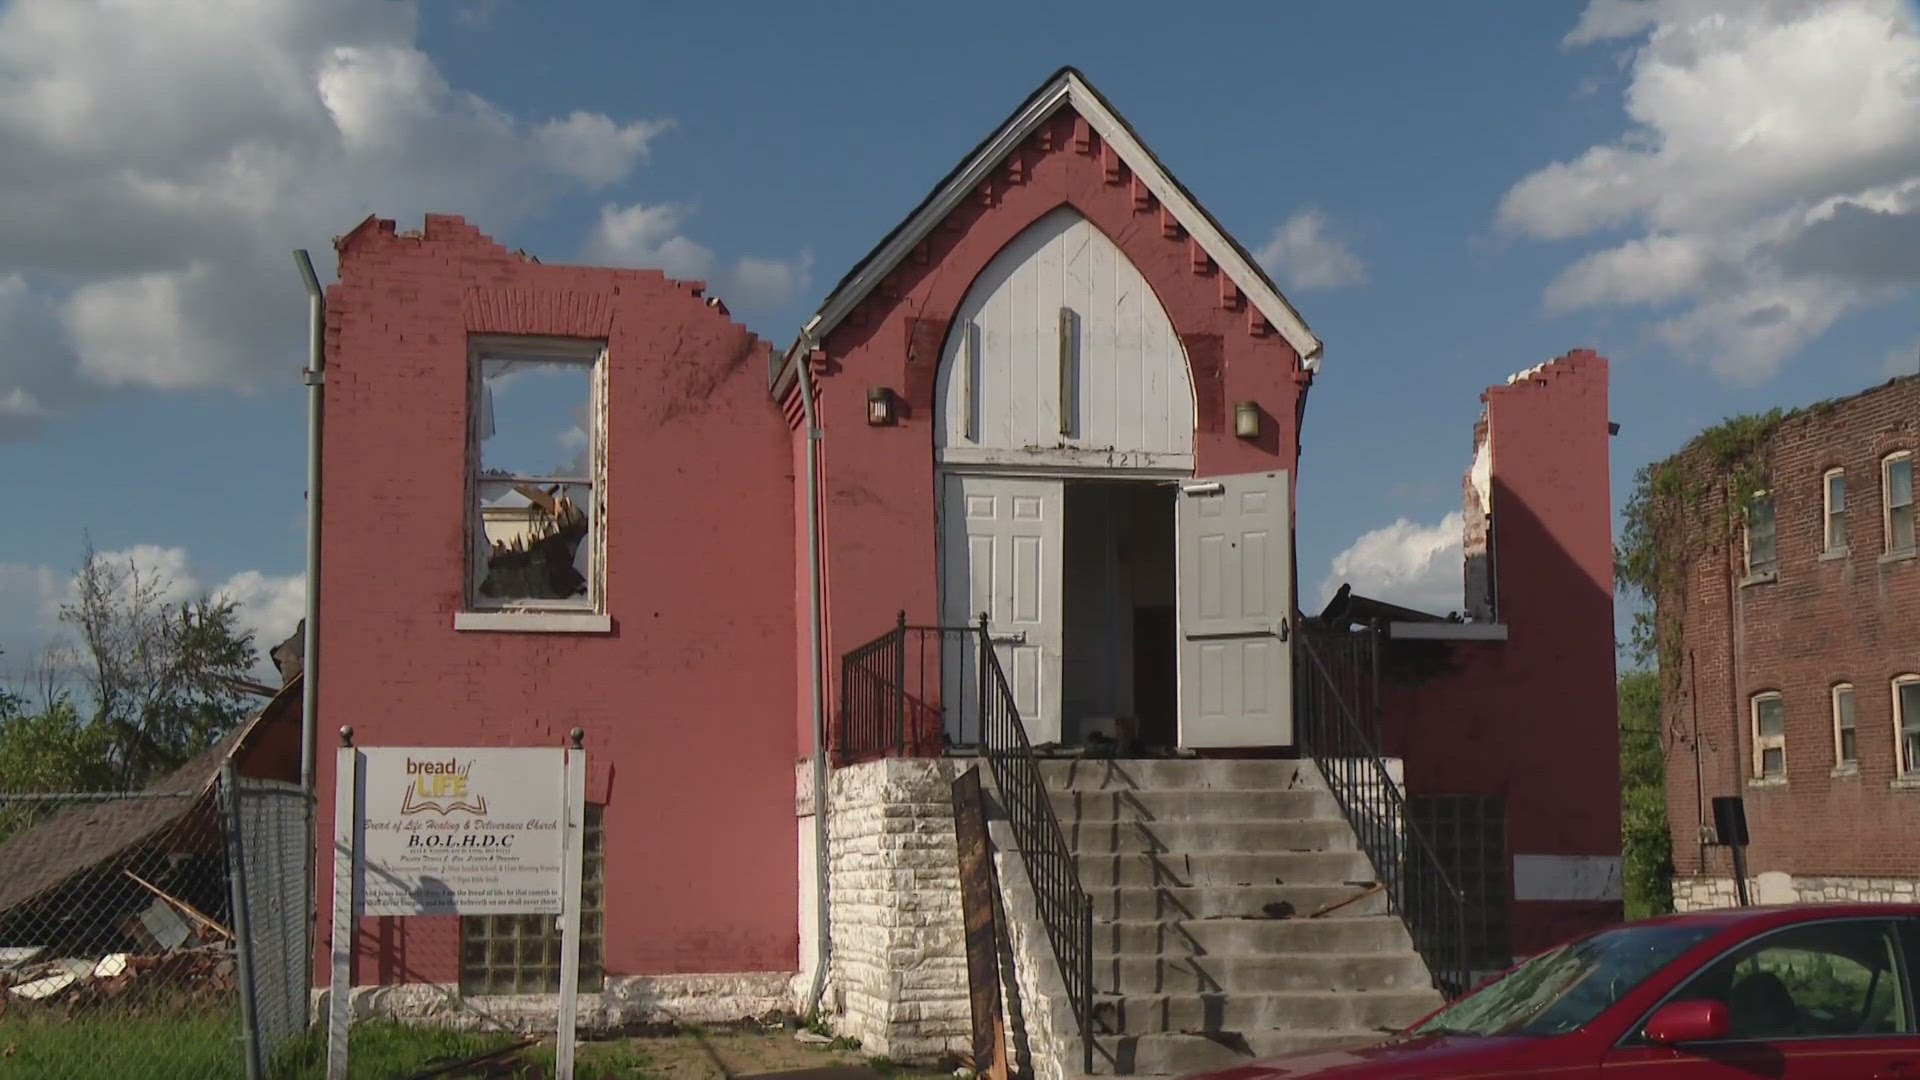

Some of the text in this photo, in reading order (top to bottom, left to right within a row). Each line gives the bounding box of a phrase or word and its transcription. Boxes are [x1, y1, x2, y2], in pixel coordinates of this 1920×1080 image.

[407, 757, 476, 780] bread of
[417, 774, 469, 798] LIFE
[364, 819, 391, 831] Bread
[392, 821, 402, 833] of
[403, 820, 422, 833] Life
[426, 819, 460, 833] Healing
[474, 819, 524, 831] Deliverance
[526, 819, 558, 831] Church
[408, 834, 515, 848] B.O.L.H.D.C
